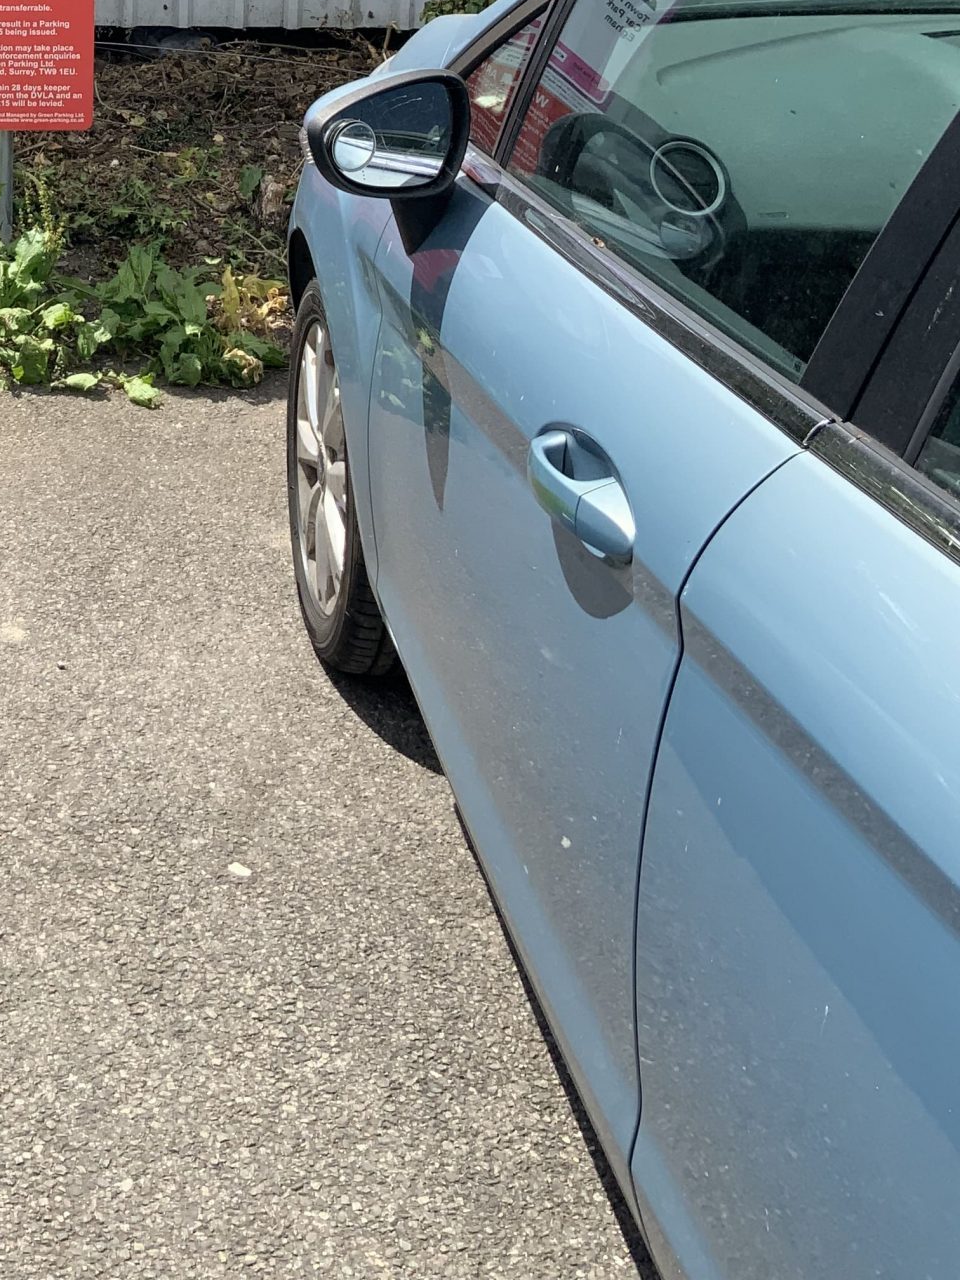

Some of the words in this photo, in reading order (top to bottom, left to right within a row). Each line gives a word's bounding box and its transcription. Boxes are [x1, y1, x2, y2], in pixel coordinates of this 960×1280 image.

[0, 4, 53, 12] transferrable.
[39, 21, 70, 30] Parking
[4, 28, 28, 37] being
[14, 46, 32, 54] may
[33, 44, 51, 52] take
[52, 44, 74, 54] place
[43, 52, 81, 61] enquiries
[8, 60, 38, 70] Parking
[40, 60, 56, 68] Ltd.
